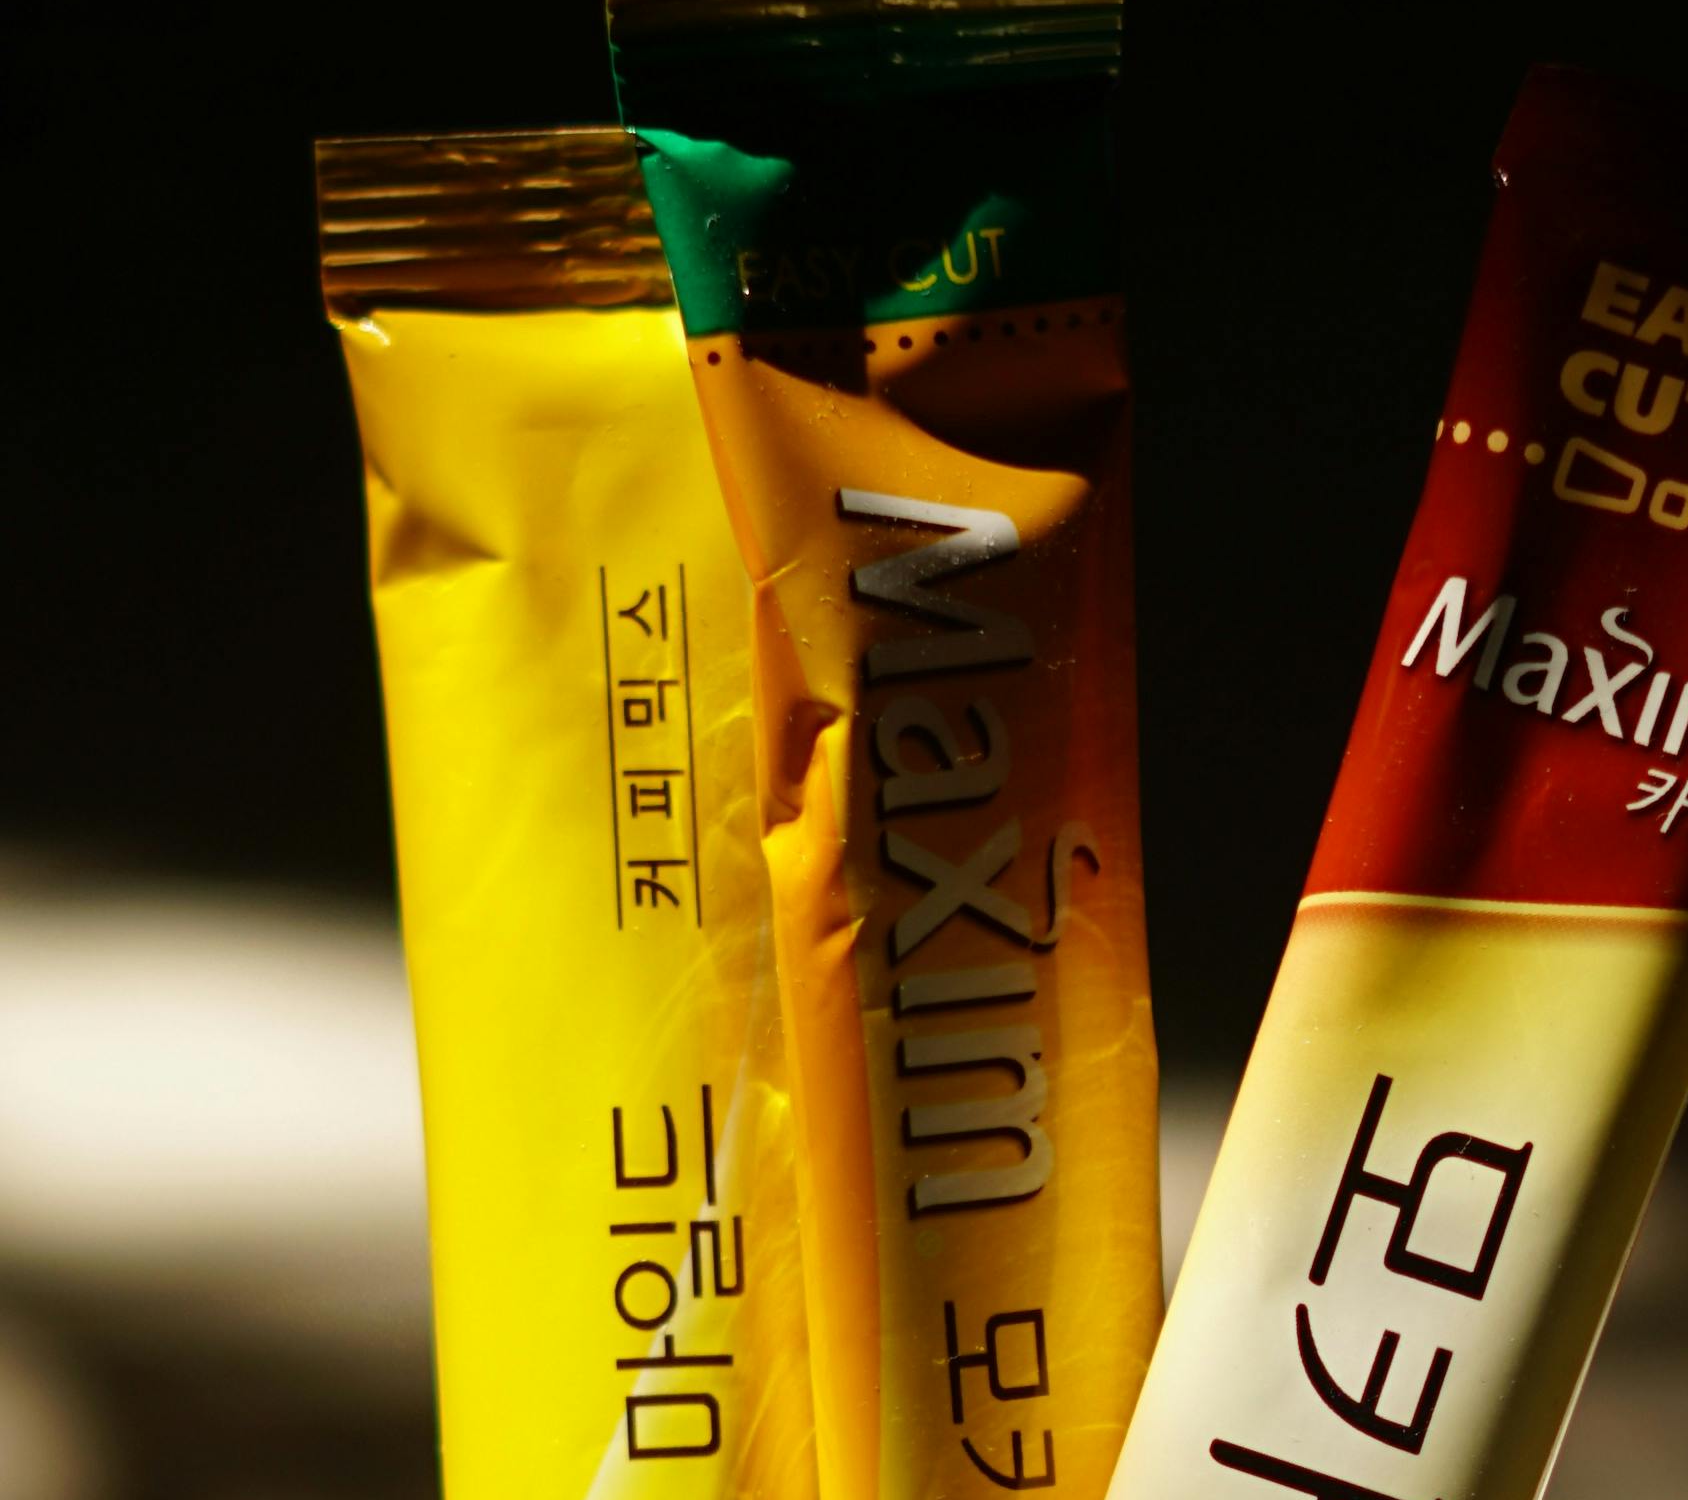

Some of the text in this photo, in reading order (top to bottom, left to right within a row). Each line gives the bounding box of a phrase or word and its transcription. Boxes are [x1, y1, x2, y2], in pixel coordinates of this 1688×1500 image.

[616, 583, 690, 910] 커피믹스
[836, 484, 1100, 1222] Maxim
[608, 1083, 745, 1462] 마일드
